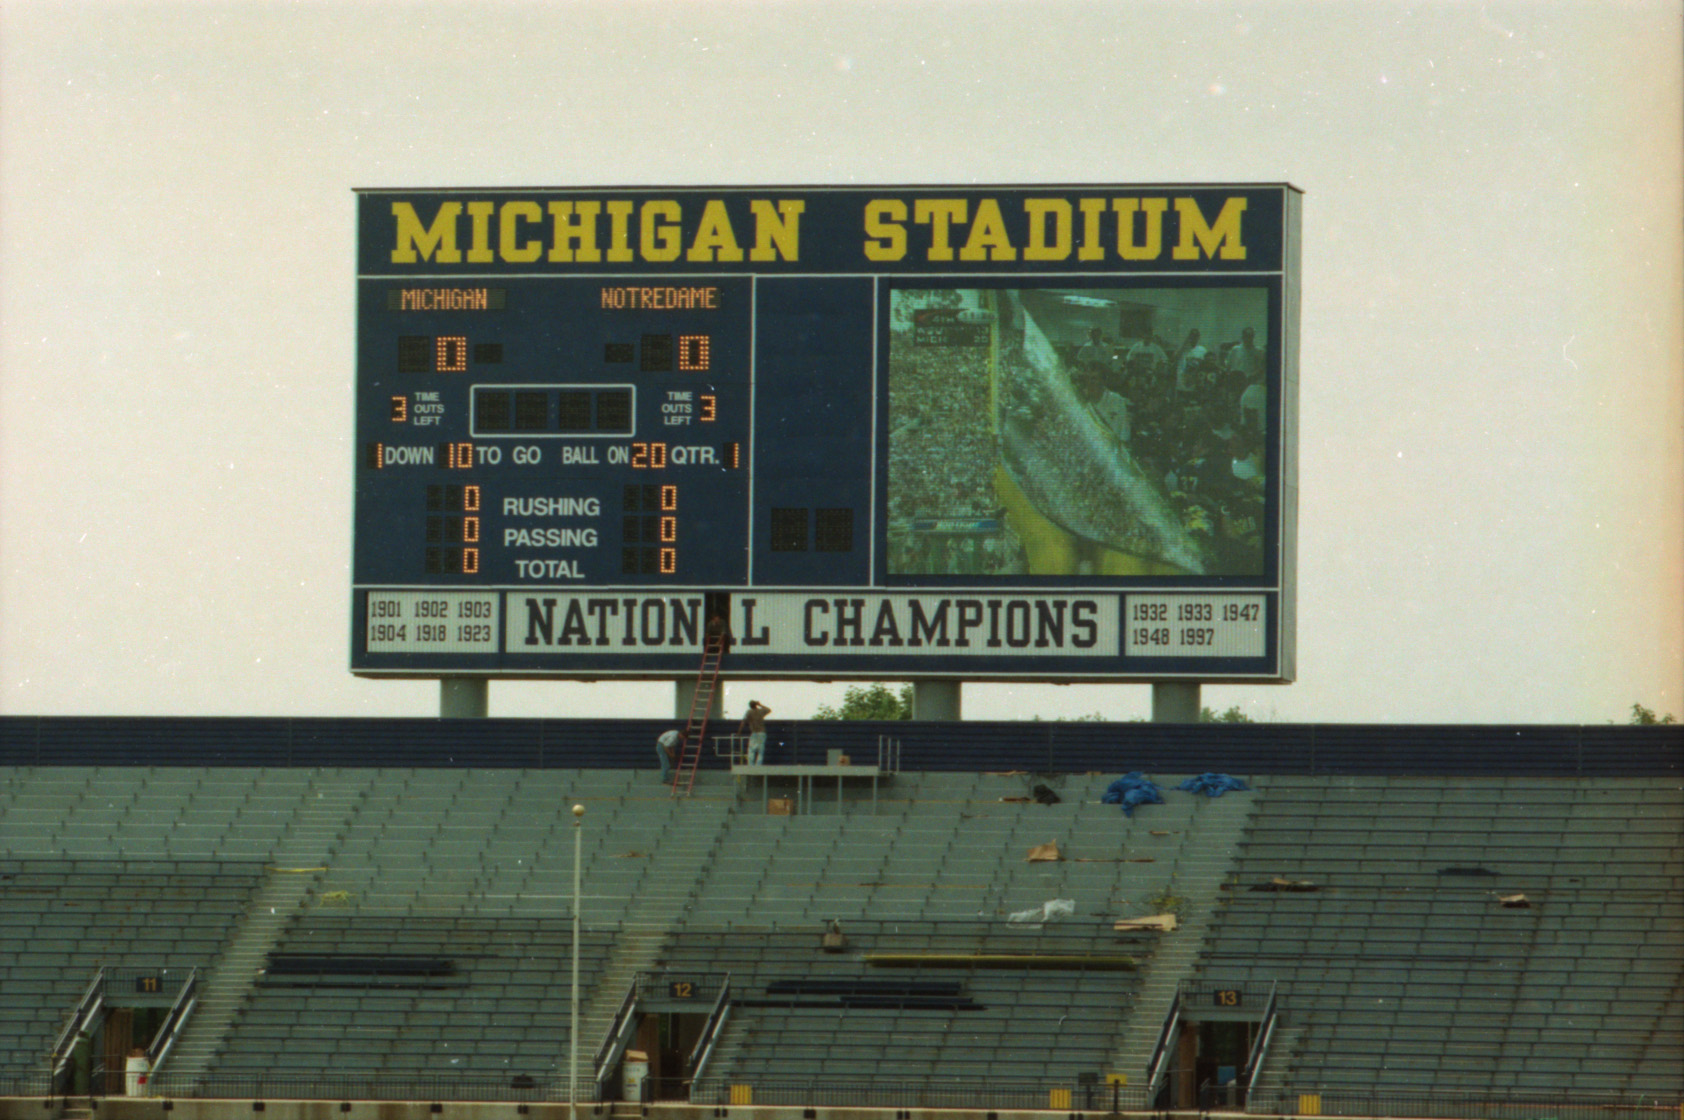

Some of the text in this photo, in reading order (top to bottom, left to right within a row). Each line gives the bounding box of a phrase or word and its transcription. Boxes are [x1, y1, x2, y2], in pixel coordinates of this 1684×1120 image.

[391, 196, 1248, 264] MICHIGAN STADIUM
[401, 288, 488, 311] MICHIGAN
[601, 287, 718, 309] NOTREDAME
[436, 336, 467, 372] 0
[679, 335, 710, 370] 0
[414, 391, 440, 402] TIME
[667, 391, 693, 402] TIME
[391, 396, 407, 421] 3
[414, 403, 445, 414] OUTS
[661, 403, 692, 414] OUTS
[700, 395, 716, 421] 3
[413, 415, 441, 426] LEFT
[664, 415, 692, 426] LEFT
[384, 446, 434, 465] DOWN
[448, 443, 473, 468] 10
[476, 446, 501, 465] TO
[513, 446, 541, 465] GO
[562, 446, 599, 464] BALL
[607, 446, 629, 464] ON
[632, 443, 666, 469] 20
[671, 446, 720, 466] QTR.
[464, 485, 480, 511] 0
[503, 498, 600, 517] RUSHING
[661, 485, 677, 511] 0
[464, 516, 479, 542] 0
[503, 528, 598, 548] PASSING
[661, 516, 676, 542] 0
[463, 548, 479, 573] 0
[515, 560, 585, 579] TOTAL
[660, 547, 676, 573] 0
[370, 600, 491, 618] 1901 1902 1903
[1132, 603, 1260, 621] 1932 1933 1947
[370, 624, 491, 642] 1904 1918 1923
[524, 598, 1098, 648] NATIONL CHAMPIONS
[1132, 628, 1215, 646] 1948 1997
[143, 978, 158, 991] 11
[674, 983, 692, 997] 12
[1218, 991, 1237, 1005] 13
